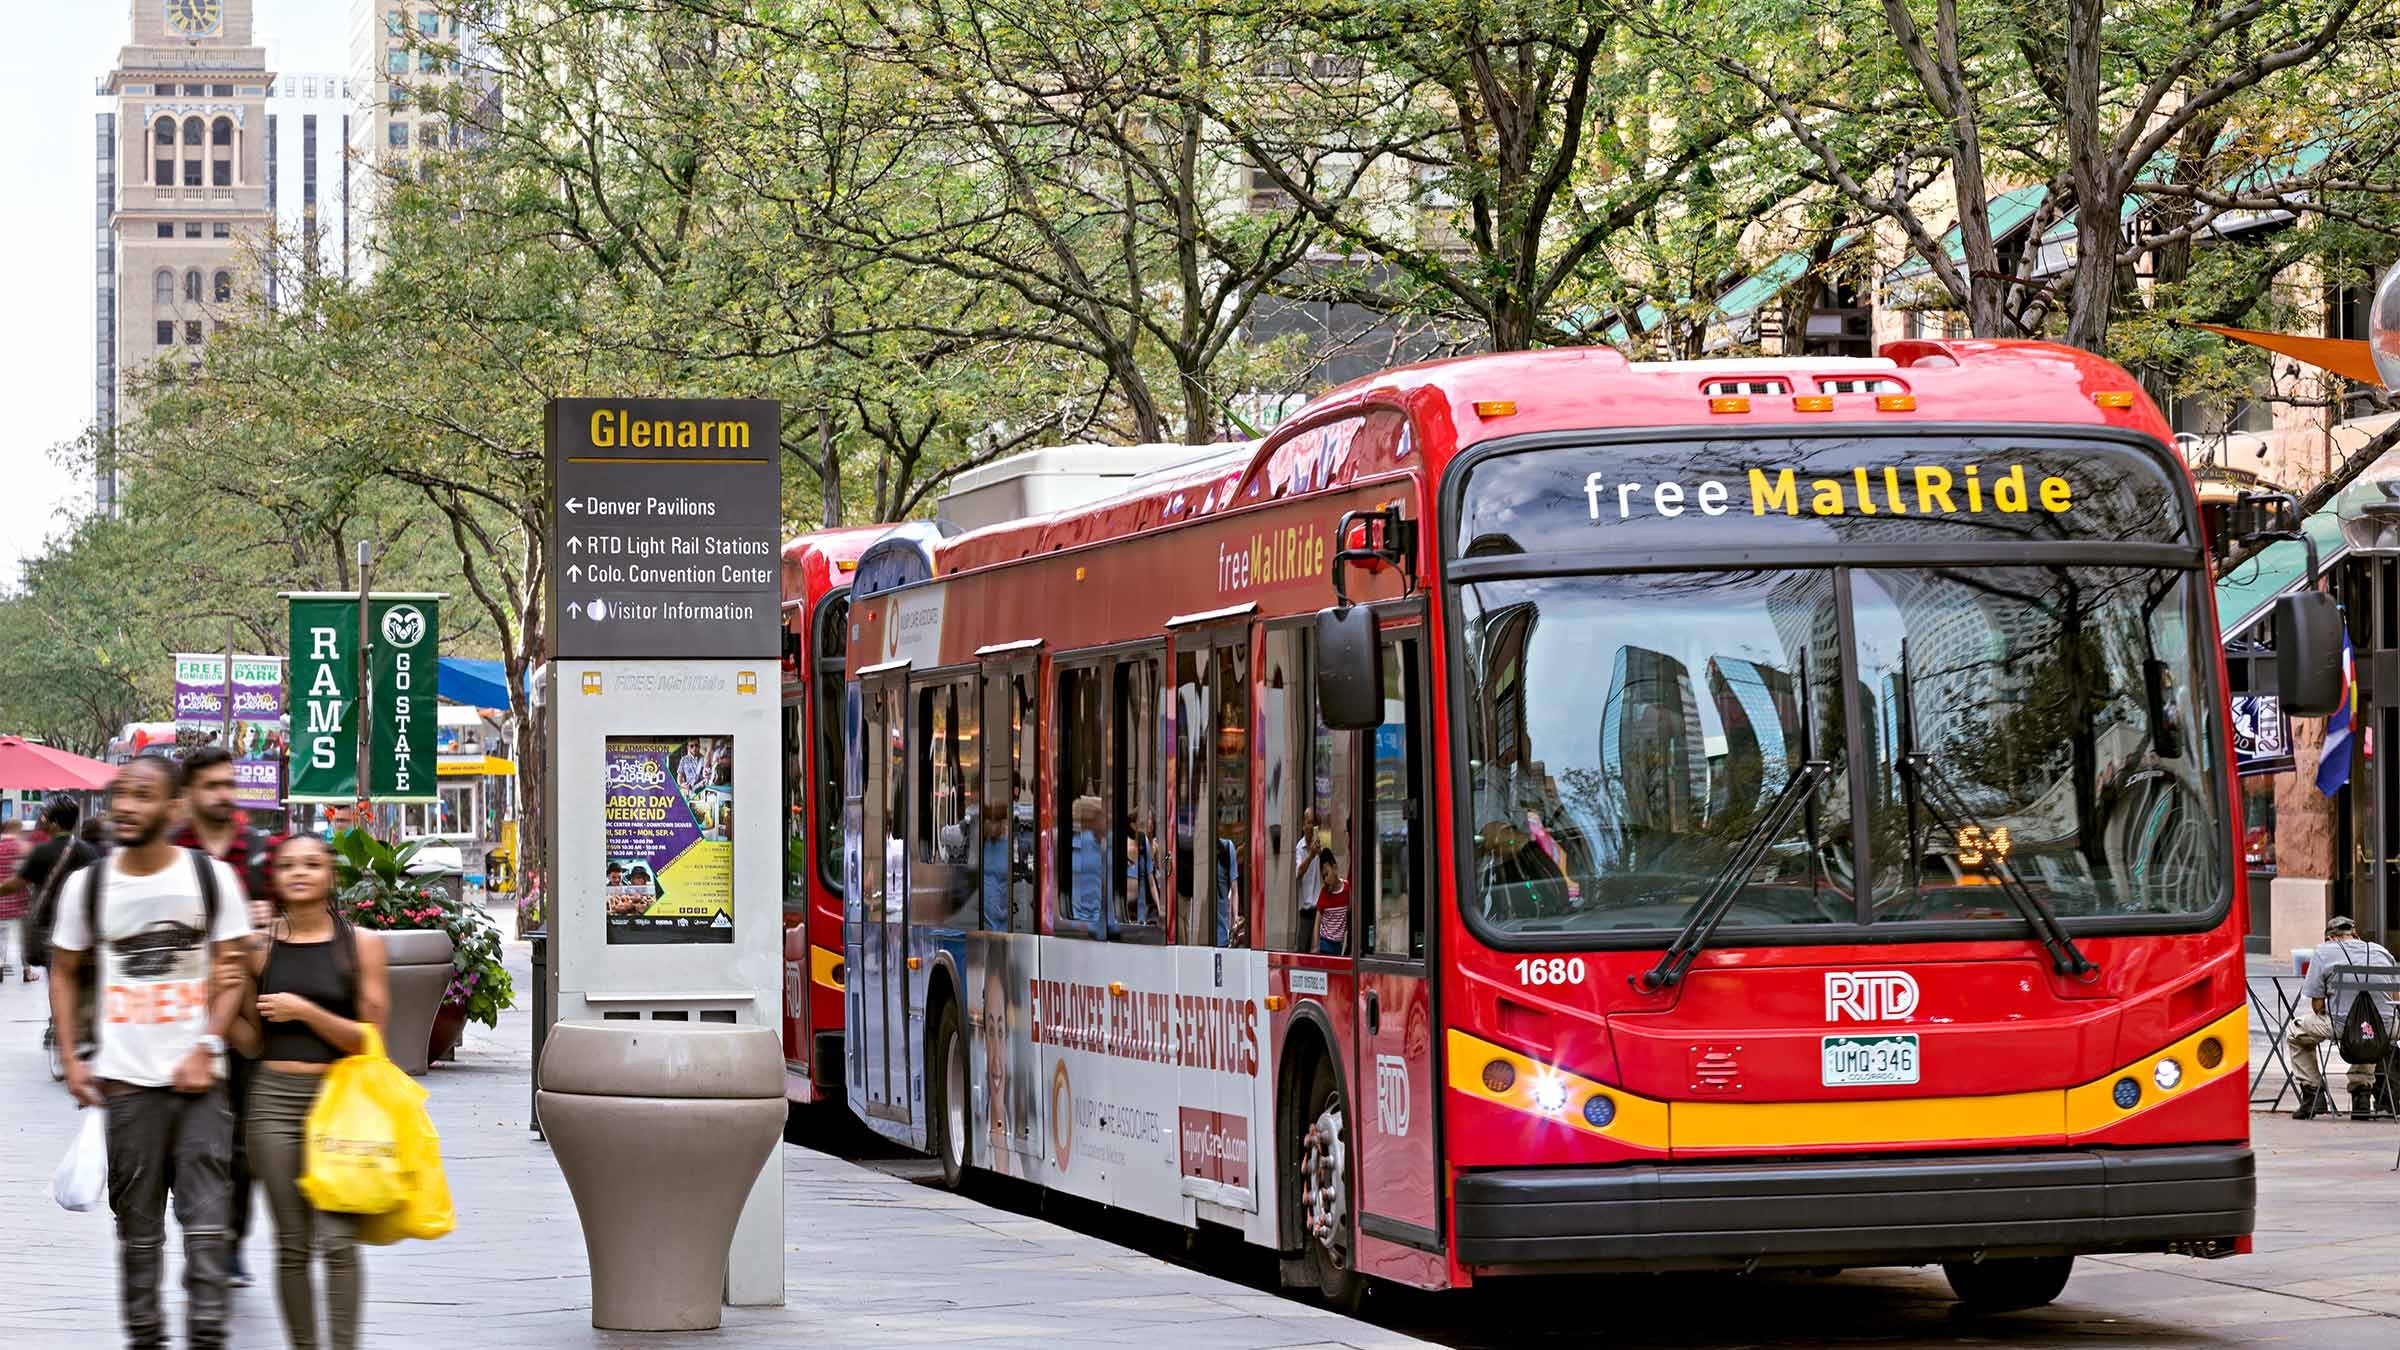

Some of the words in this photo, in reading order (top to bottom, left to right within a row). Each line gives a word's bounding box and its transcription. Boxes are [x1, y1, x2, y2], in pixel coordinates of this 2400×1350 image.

[590, 409, 750, 449] Glenarm
[587, 497, 641, 515] Denver
[647, 497, 716, 516] Pavilions
[588, 536, 621, 554] RTD
[627, 536, 665, 558] Light
[671, 537, 699, 554] Rail
[705, 537, 769, 555] Stations
[588, 565, 625, 583] Colo.
[629, 565, 715, 583] Convention
[722, 565, 773, 583] Center
[608, 601, 657, 620] Visitor
[663, 601, 753, 620] Information
[179, 663, 222, 673] FREE
[179, 672, 222, 680] ADMISSION
[234, 671, 278, 680] PARK
[252, 663, 279, 671] CENTER
[396, 653, 411, 691] GO
[307, 627, 342, 769] RAMS
[394, 696, 411, 791] STATE
[607, 744, 622, 752] REE
[623, 744, 670, 753] ADMISSION
[606, 796, 646, 808] ABOR
[649, 796, 676, 808] DAY
[1514, 957, 1585, 986] 1680
[1824, 970, 1920, 1022] RTD
[1030, 979, 1105, 1055] EMPLOYEE
[1109, 986, 1171, 1064] HEALTH
[1175, 992, 1259, 1079] SERVICES
[1848, 1072, 1895, 1080] COLORADO
[1376, 1054, 1410, 1137] RTD
